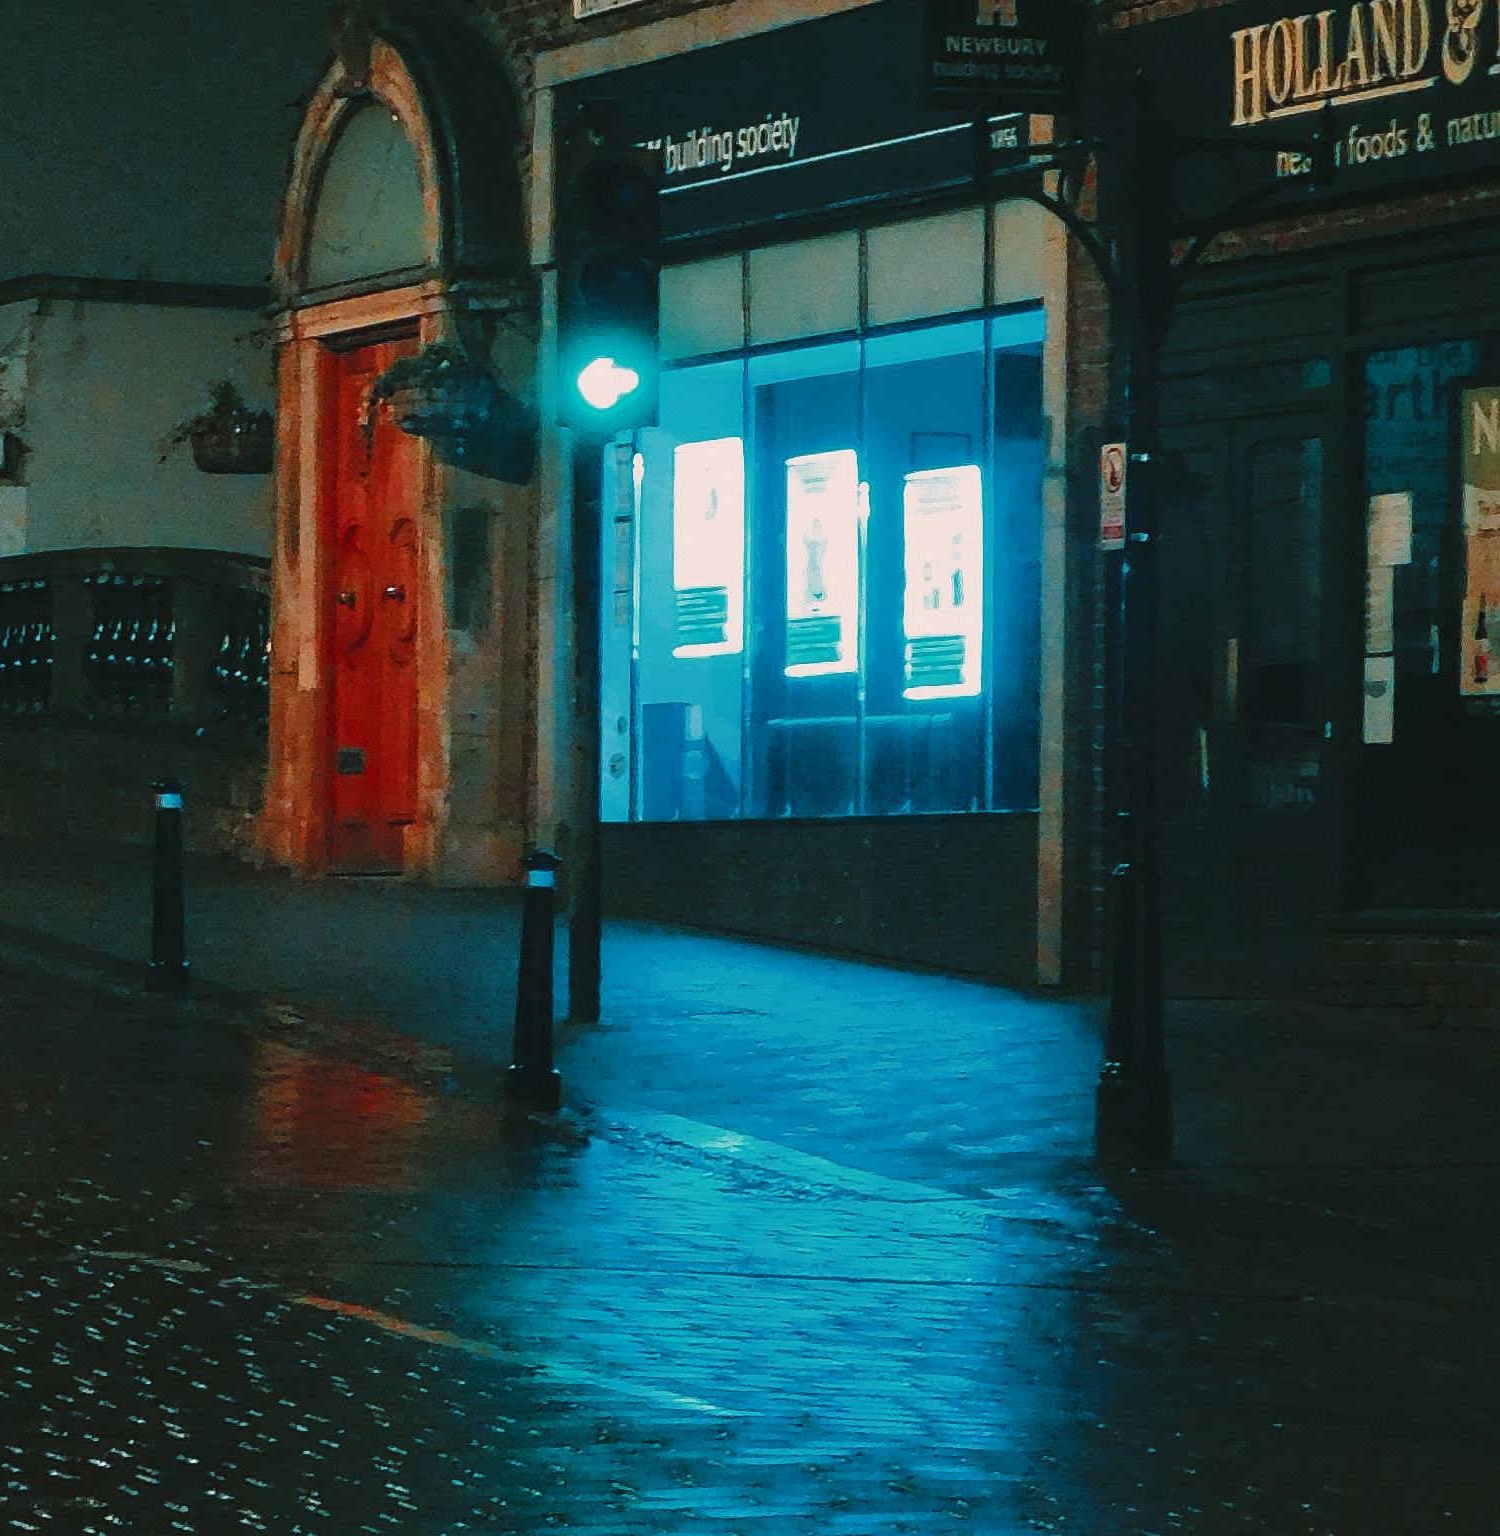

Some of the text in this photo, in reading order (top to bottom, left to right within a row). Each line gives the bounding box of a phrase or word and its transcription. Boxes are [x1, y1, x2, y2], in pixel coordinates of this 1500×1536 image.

[945, 36, 1049, 56] NEWBURY
[664, 111, 800, 175] building society
[1348, 117, 1408, 165] foods
[1416, 112, 1435, 152] &
